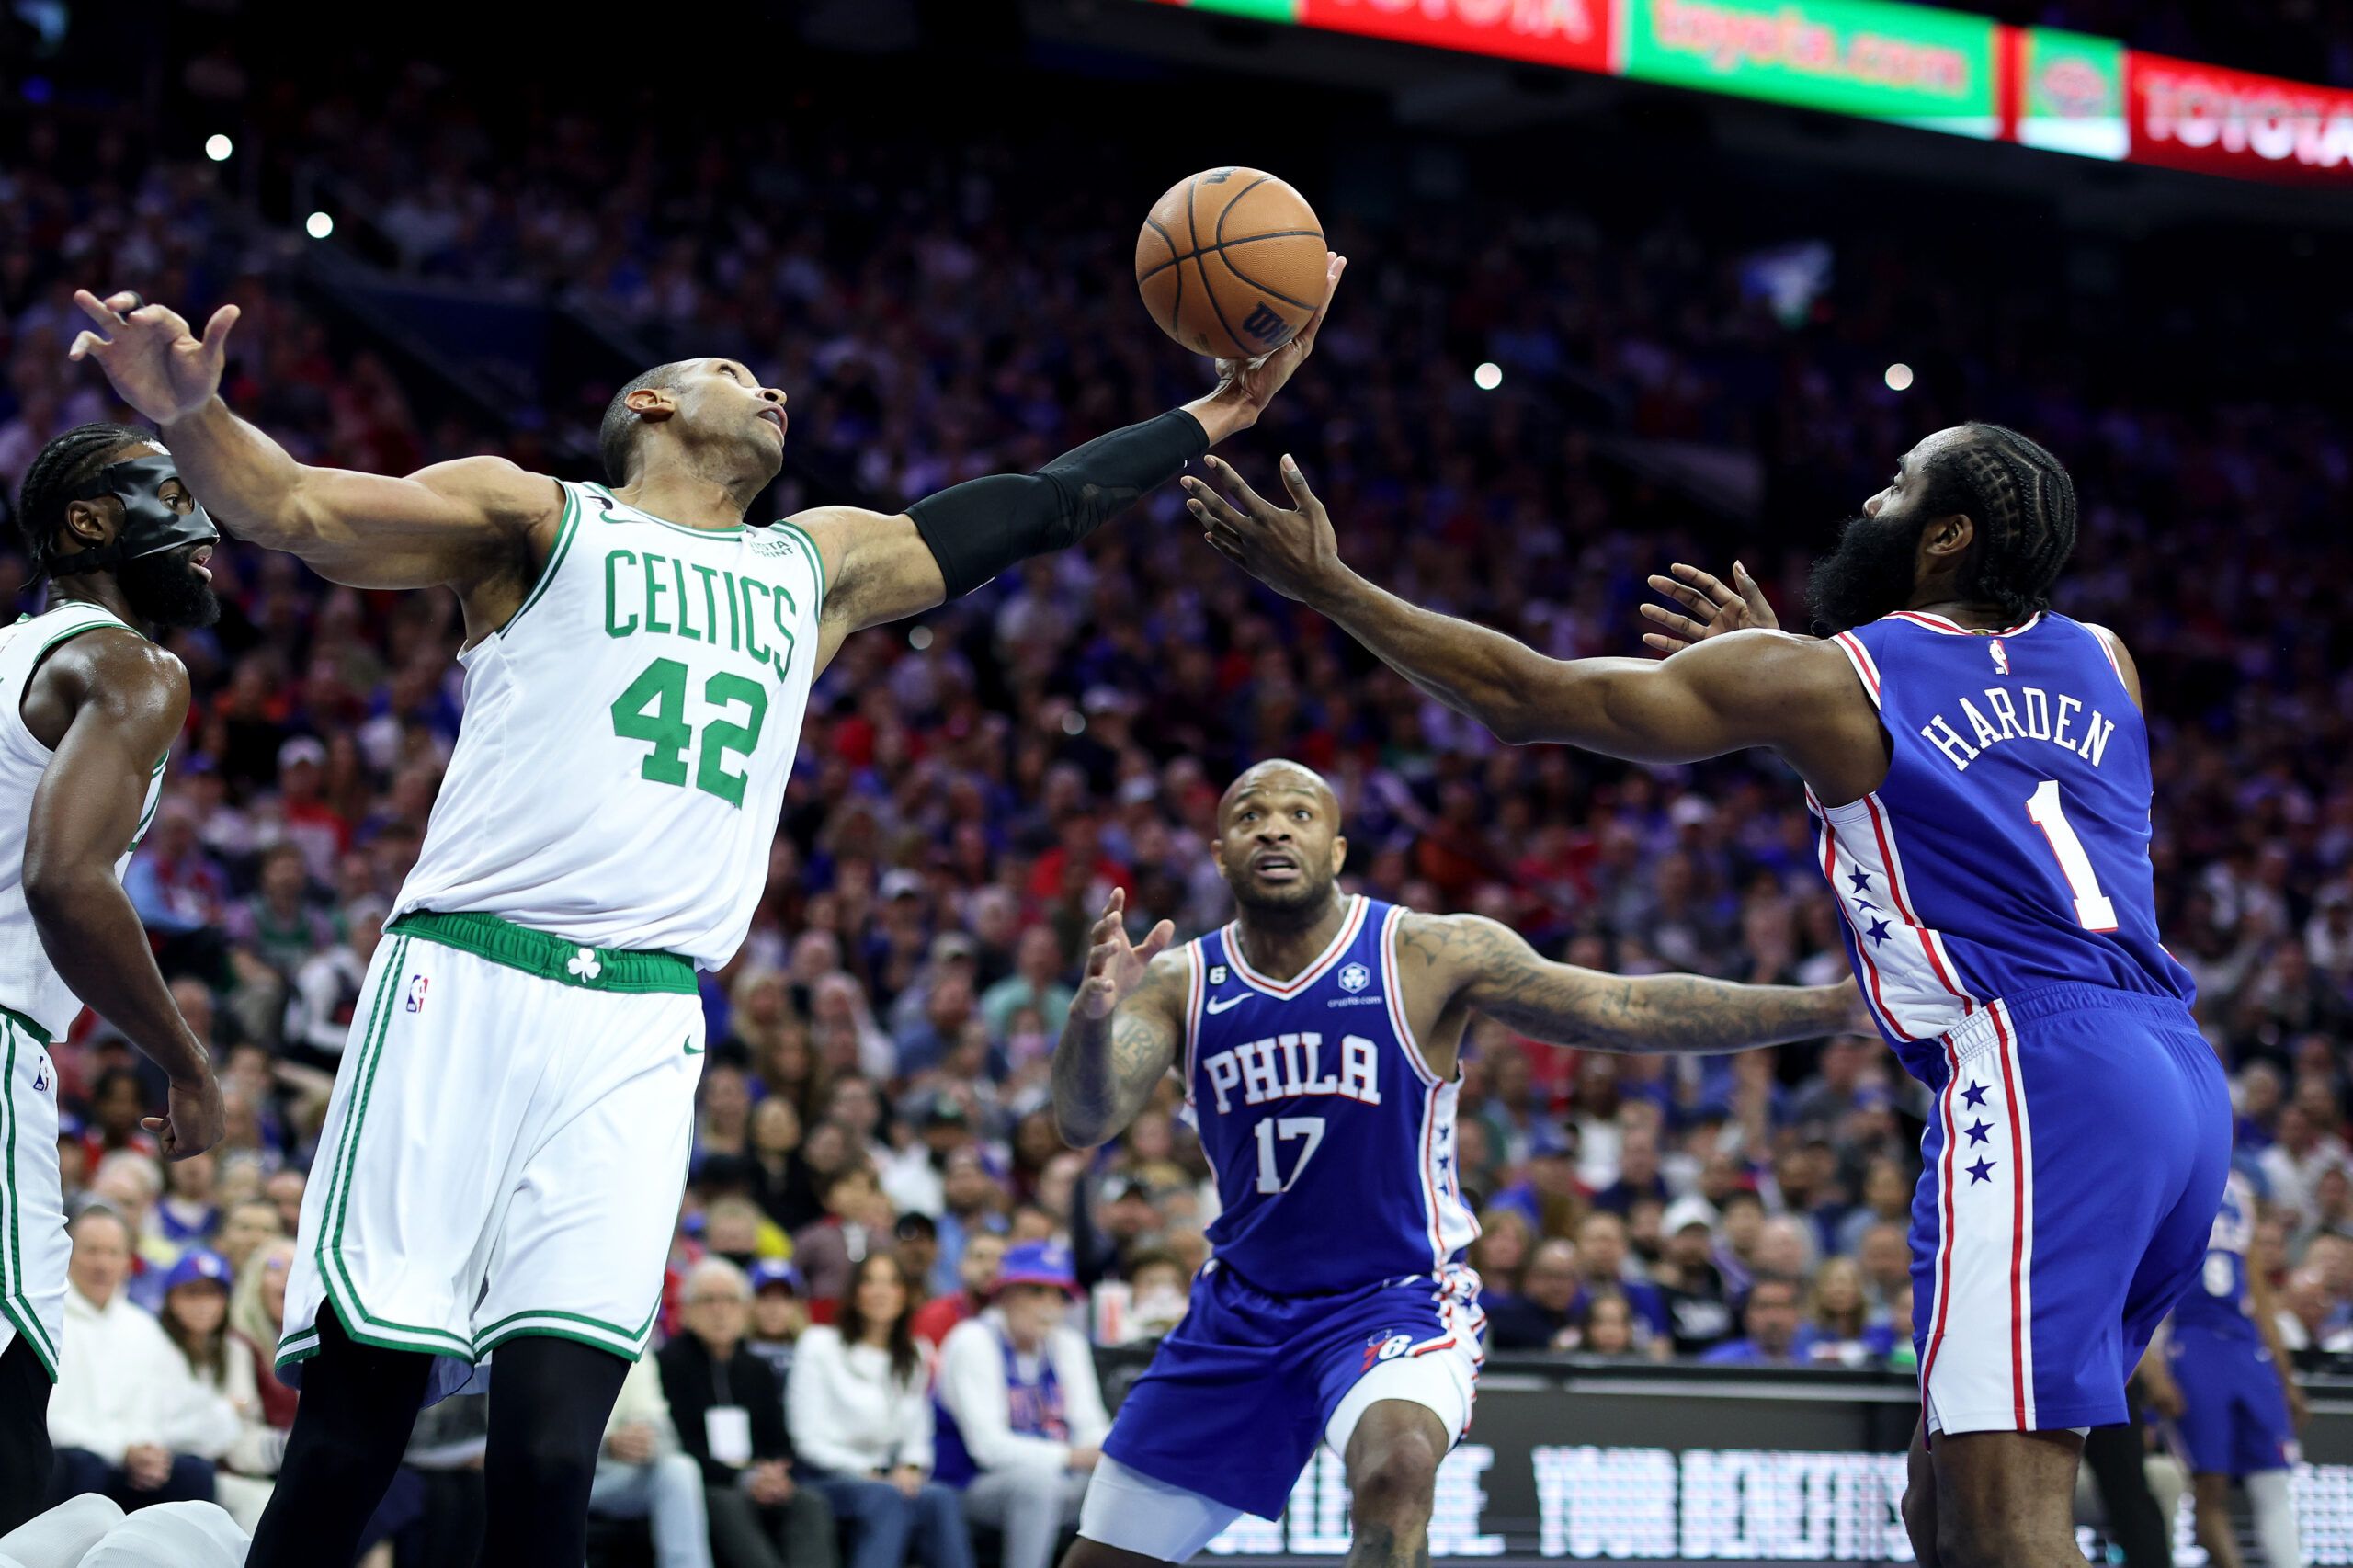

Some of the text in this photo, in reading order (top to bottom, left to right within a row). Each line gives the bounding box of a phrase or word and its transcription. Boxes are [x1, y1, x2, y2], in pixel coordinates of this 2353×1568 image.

[605, 550, 797, 684] CELTICS
[610, 656, 768, 810] 42
[1921, 687, 2115, 772] HARDEN
[2025, 779, 2119, 933] 1
[1209, 966, 1227, 985] 6
[1202, 1031, 1381, 1115] PHILA
[1254, 1116, 1326, 1194] 17
